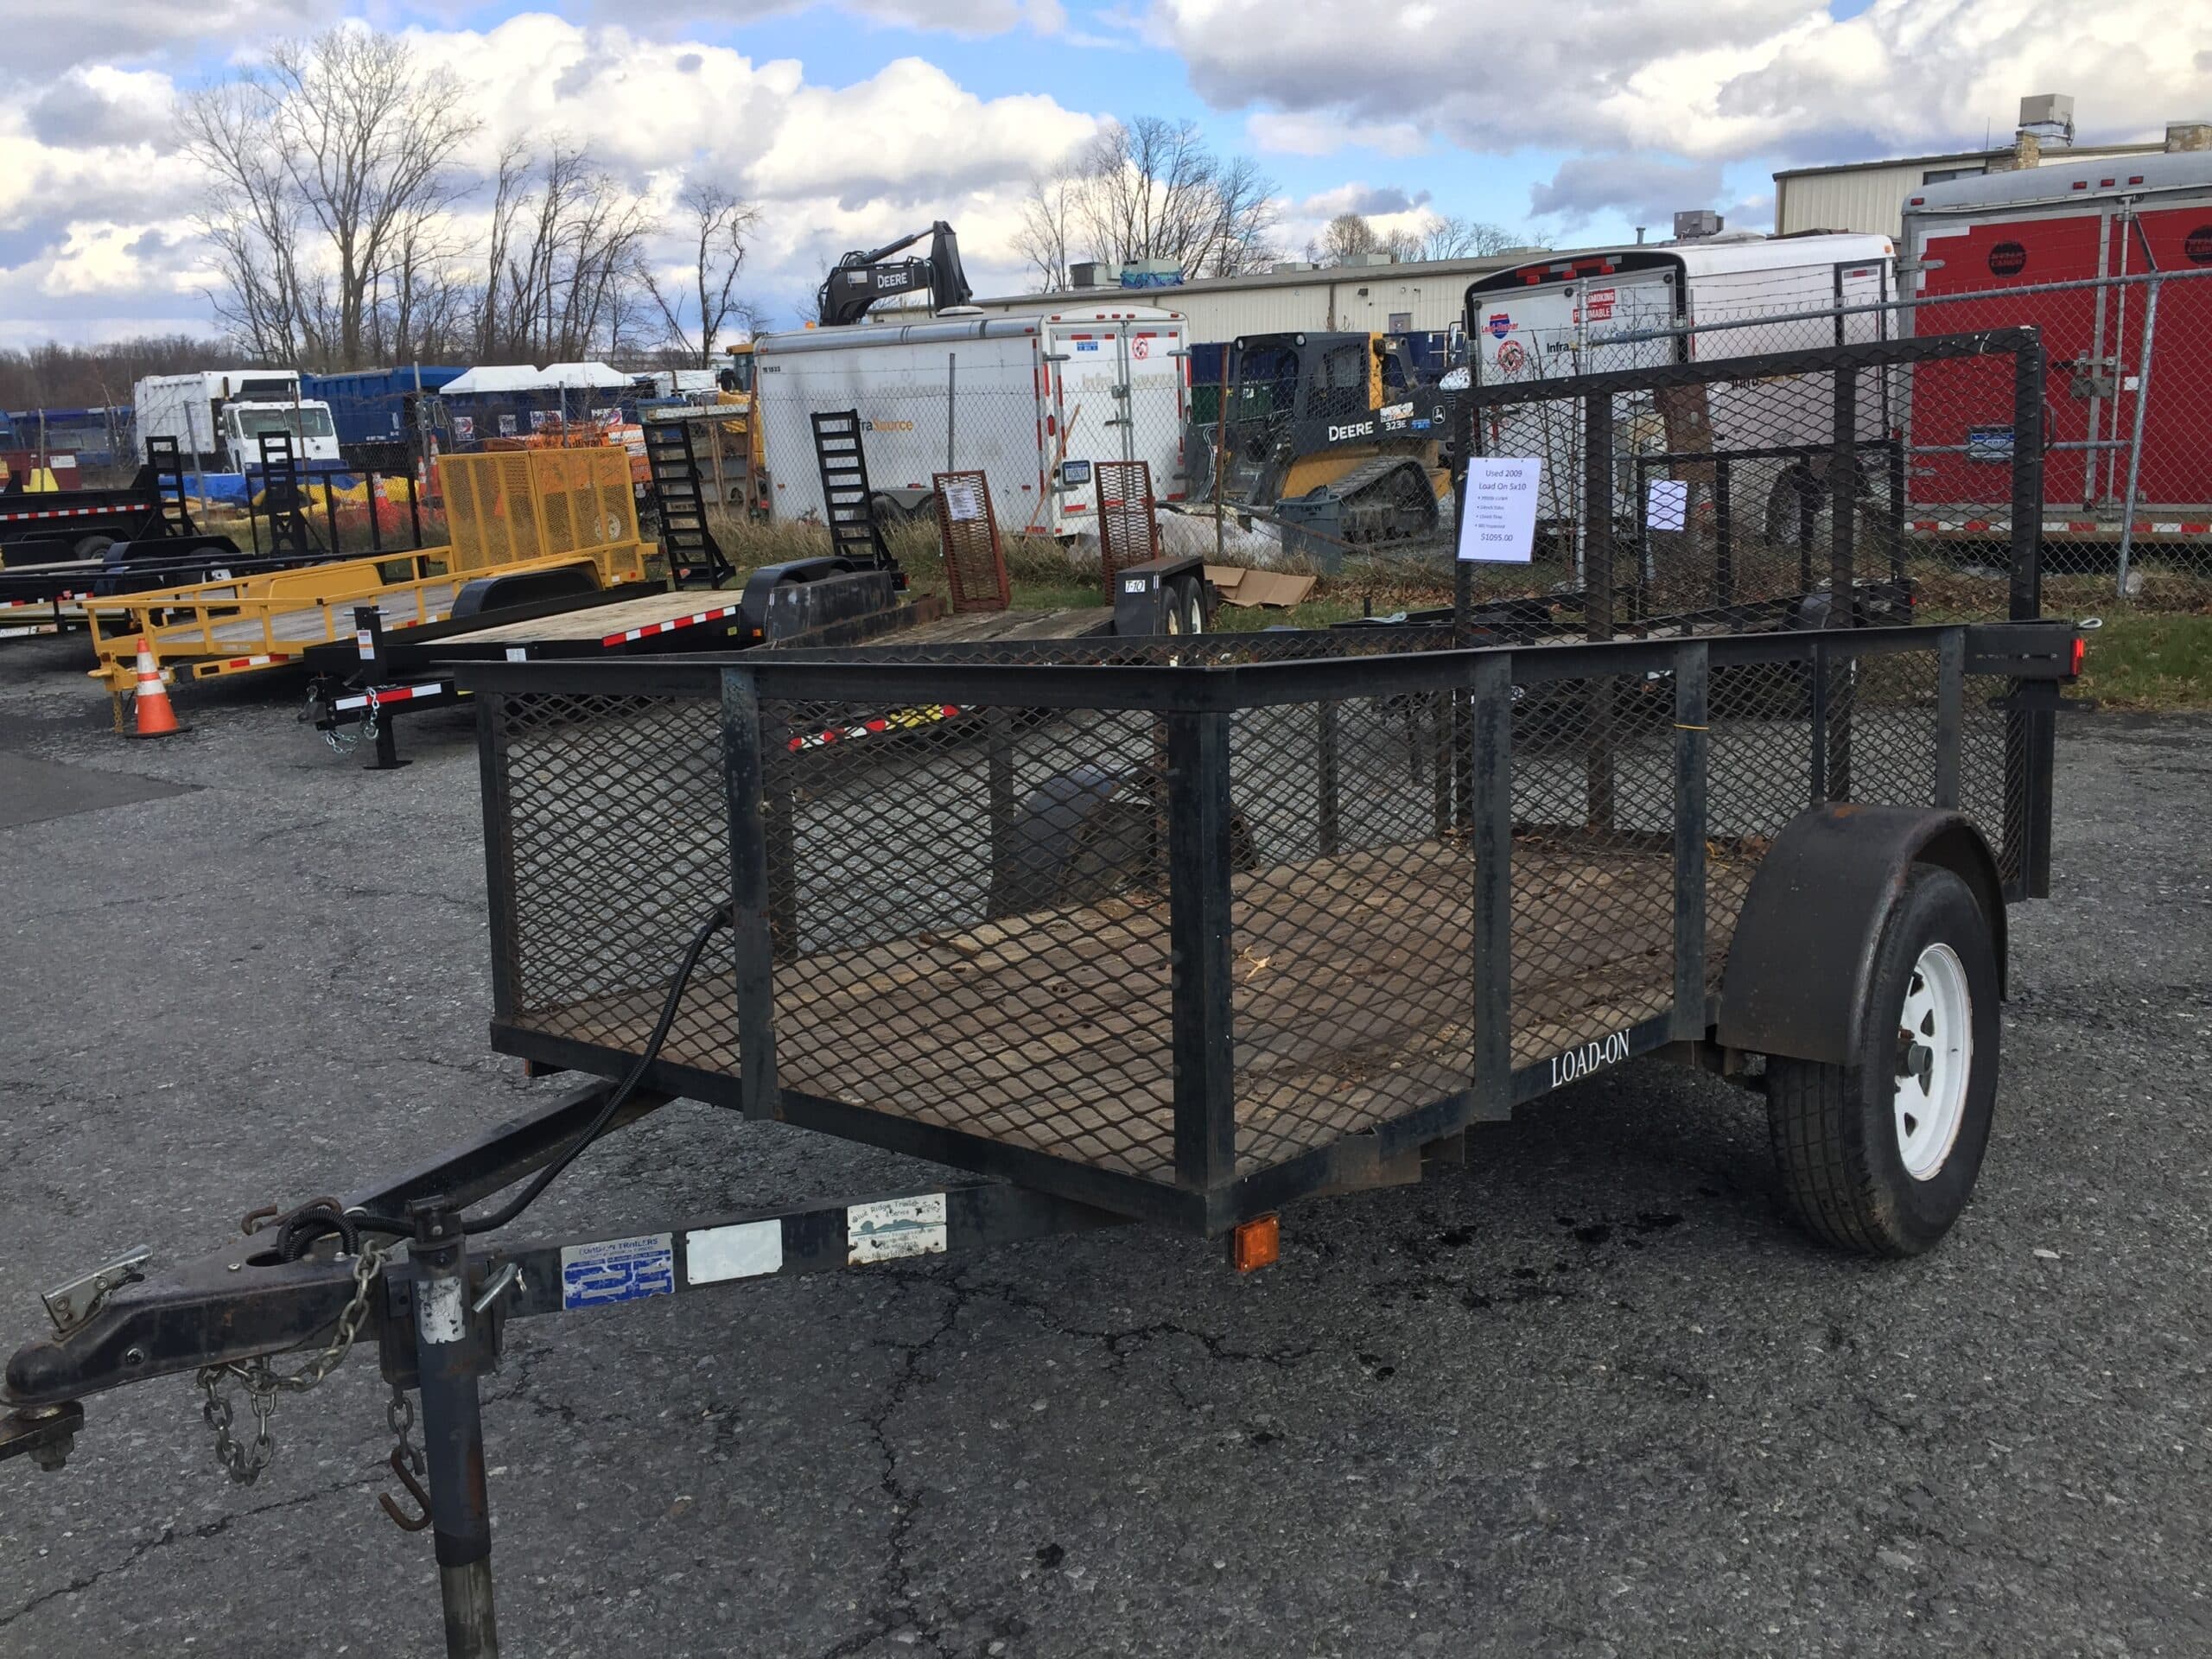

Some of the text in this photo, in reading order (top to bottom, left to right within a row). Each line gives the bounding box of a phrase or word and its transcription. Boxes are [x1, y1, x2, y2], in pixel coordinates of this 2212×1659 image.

[877, 272, 908, 289] DEERE
[1385, 420, 1408, 431] 323E
[1328, 421, 1374, 442] DEERE
[1127, 581, 1144, 592] T-10
[1551, 1027, 1630, 1088] LOAD-ON
[871, 1205, 892, 1213] Ridge
[619, 1238, 658, 1249] TRAILERS
